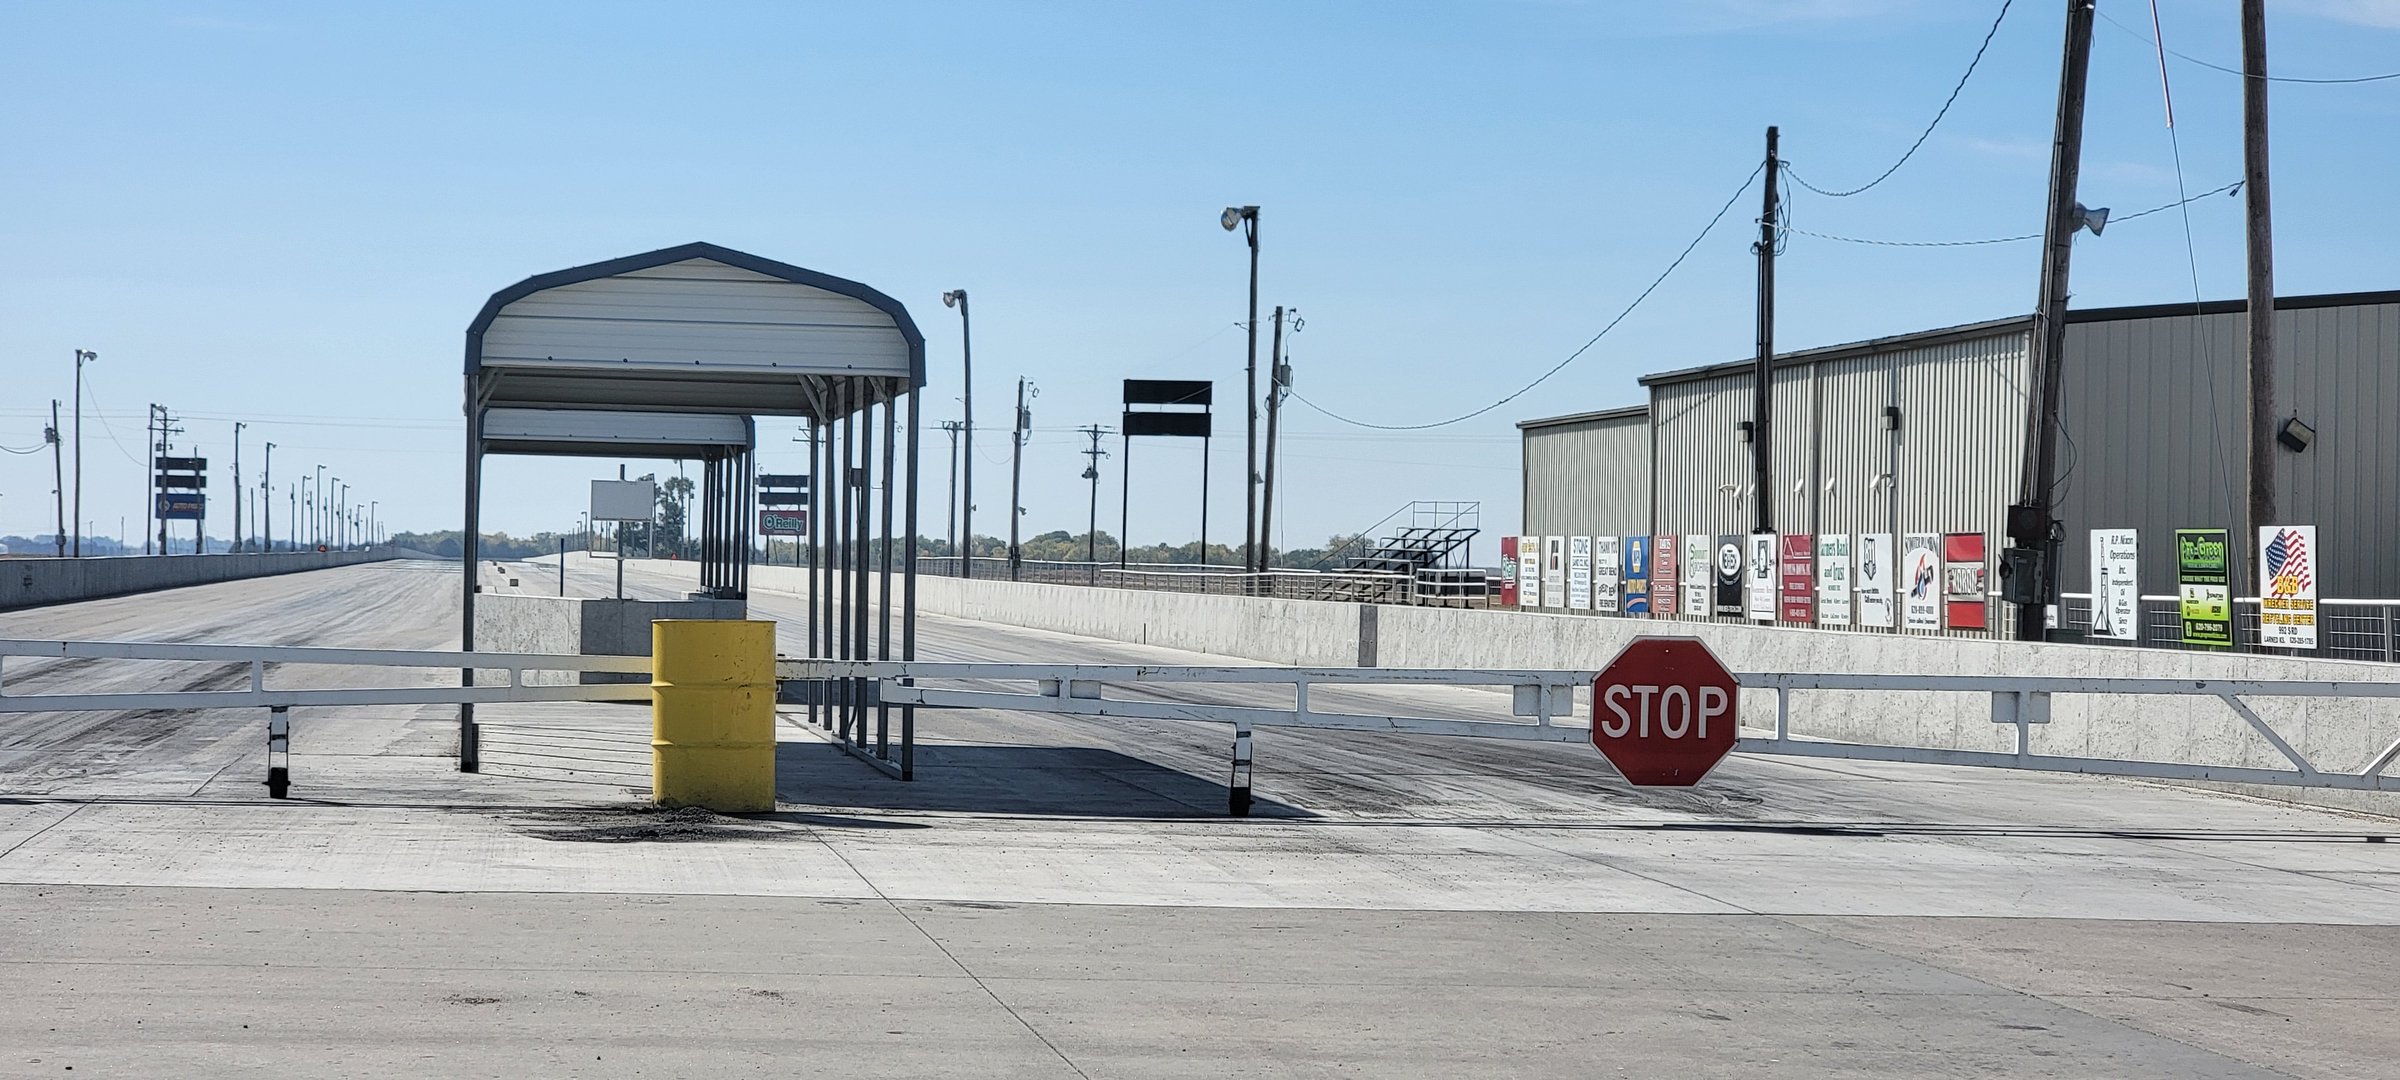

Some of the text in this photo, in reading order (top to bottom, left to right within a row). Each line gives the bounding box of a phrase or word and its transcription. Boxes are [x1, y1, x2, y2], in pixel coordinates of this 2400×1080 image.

[763, 514, 803, 532] O'Reilly
[1573, 538, 1588, 554] STONE
[2110, 549, 2136, 561] Operations
[2277, 575, 2299, 595] B&B
[2292, 614, 2314, 626] CENTER
[1601, 684, 1728, 739] STOP
